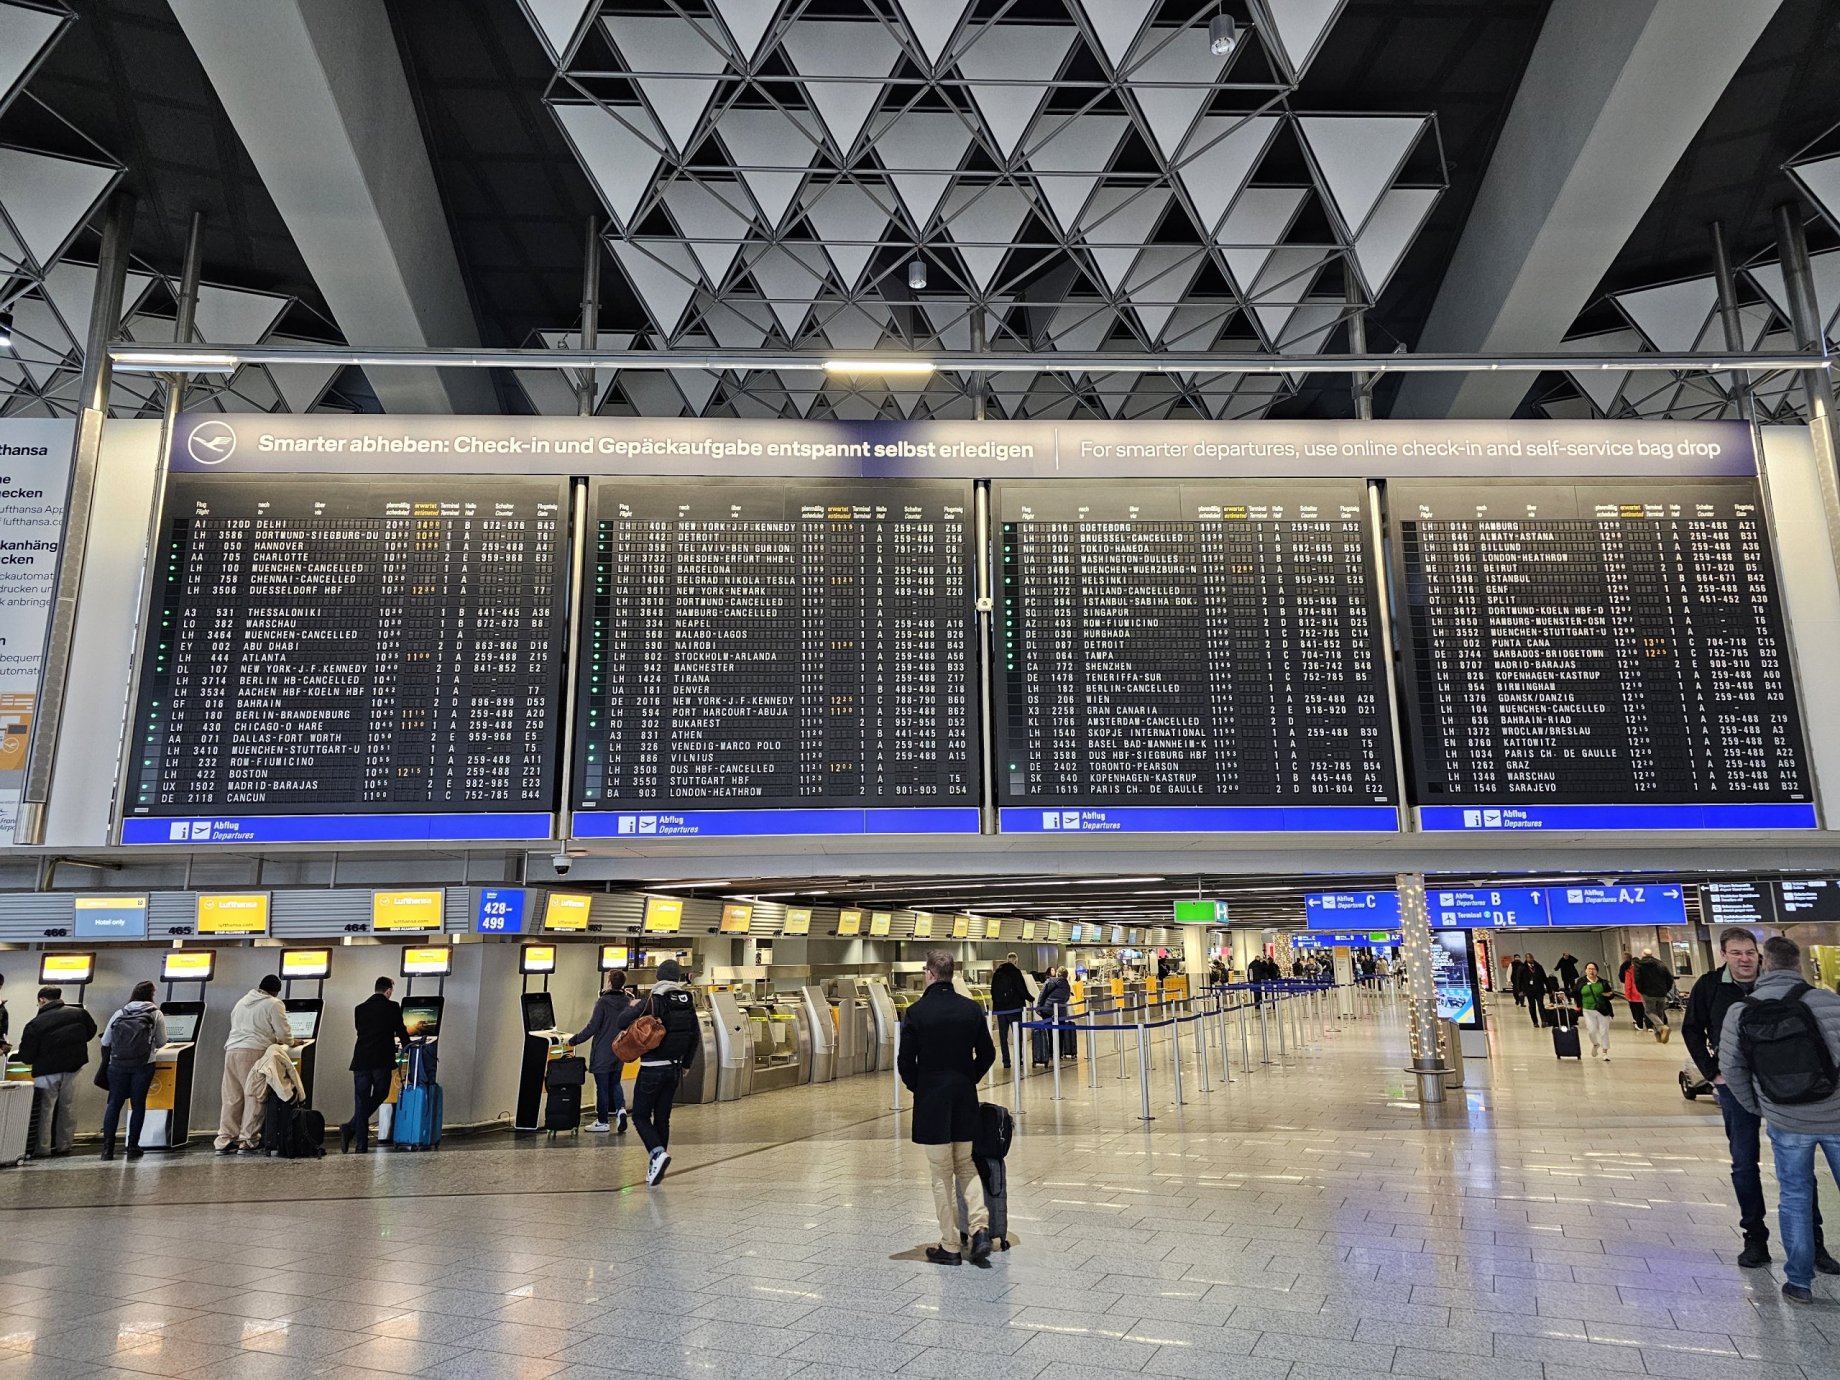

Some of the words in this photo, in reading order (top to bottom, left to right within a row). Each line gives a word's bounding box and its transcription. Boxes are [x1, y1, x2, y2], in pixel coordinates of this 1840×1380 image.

[258, 435, 347, 452] Smarter
[350, 436, 449, 452] abheben:
[454, 436, 549, 453] Check-in
[555, 438, 593, 453] und
[598, 438, 762, 458] Gepäckaufgabe
[767, 441, 870, 460] entspannt
[874, 439, 936, 458] selbst
[940, 441, 1033, 461] erledigen
[1082, 441, 1112, 457] For
[1116, 443, 1189, 457] smarter
[1193, 438, 1299, 460] departures,
[1304, 444, 1337, 456] use
[1342, 440, 1397, 456] online
[1402, 439, 1485, 456] check-in
[1487, 440, 1522, 456] and
[1526, 440, 1633, 456] self-service
[1637, 439, 1674, 459] bag
[1677, 439, 1721, 459] drop
[257, 520, 286, 528] DELHI
[678, 533, 719, 541] DETROIT
[254, 542, 303, 550] HANNOVER
[1481, 543, 1521, 551] BILLUND
[253, 553, 308, 561] CHARLOTTE
[678, 565, 730, 573] BARCELONA
[1082, 576, 1126, 584] HELSINKI
[1486, 575, 1530, 583] ISTANBUL
[1487, 596, 1515, 604] SPLIT
[248, 608, 321, 617] THESSALONIKI
[1083, 608, 1129, 616] SINGAPUR
[246, 619, 296, 628] WARSCHAU
[676, 619, 710, 627] NEAPEL
[675, 641, 715, 649] NAIROBI
[242, 653, 286, 662] ATLANTA
[675, 652, 776, 660] STOCKHOLM-ARLANDA
[1085, 651, 1113, 659] TAMPA
[674, 663, 734, 672] MANCHESTER
[1086, 662, 1131, 671] SHENZHEN
[1086, 673, 1161, 681] TENERIFFA-SUR
[673, 686, 709, 694] DENVER
[1497, 683, 1555, 691] BIRMINGHAM
[1086, 695, 1109, 703] WIEN
[1498, 693, 1574, 702] GDANSK/DANZIG
[237, 699, 281, 708] BAHRAIN
[672, 719, 720, 728] BUKAREST
[1501, 716, 1571, 724] BAHRAIN-RIAD
[234, 722, 292, 731] CHICAGO-O
[298, 722, 322, 730] HARE
[610, 731, 621, 740] A3
[641, 731, 658, 739] 831
[671, 731, 702, 739] ATHEN
[895, 729, 936, 737] 441-445
[948, 729, 965, 737] A34
[1088, 728, 1122, 737] SKOPJE
[1131, 728, 1206, 737] INTERNATIONAL
[233, 734, 303, 743] DALLAS-FORT
[310, 733, 341, 742] WORTH
[1503, 738, 1556, 746] KATTOWITZ
[672, 741, 750, 750] VENEDIG-MARCO
[757, 741, 781, 750] POLO
[166, 759, 178, 767] LH
[198, 758, 217, 767] 232
[230, 757, 314, 766] ROM-FIUMICINO
[468, 755, 510, 764] 259-488
[523, 755, 541, 763] A11
[671, 753, 713, 762] VILNIUS
[1030, 762, 1041, 771] DE
[1054, 762, 1076, 771] 2402
[1089, 762, 1178, 771] TORONTO-PEARSON
[1311, 762, 1351, 770] 752-785
[1363, 762, 1380, 770] B54
[1506, 761, 1529, 769] GRAZ
[229, 769, 268, 778] BOSTON
[1090, 773, 1196, 782] KOPENHAGEN-KASTRUP
[1448, 773, 1459, 781] LH
[1473, 772, 1495, 781] 1348
[1507, 772, 1555, 780] WARSCHAU
[1727, 771, 1768, 779] 259-488
[1780, 771, 1797, 779] A14
[163, 782, 176, 791] UX
[191, 782, 214, 791] 1502
[228, 780, 318, 790] MADRID-BARAJAS
[466, 779, 509, 787] 982-985
[523, 778, 540, 787] E23
[1031, 785, 1041, 793] AF
[1056, 785, 1078, 793] 1619
[1091, 785, 1120, 793] PARIS
[1126, 785, 1143, 793] CH.
[1150, 785, 1161, 793] DE
[1168, 785, 1203, 793] GAULLE
[1312, 784, 1353, 793] 801-804
[1366, 784, 1383, 792] E22
[1449, 784, 1461, 792] LH
[1474, 784, 1496, 792] 1546
[1509, 783, 1556, 792] SARAJEVO
[1729, 782, 1769, 790] 259-488
[1781, 782, 1798, 790] B32
[607, 789, 619, 797] BA
[639, 789, 656, 797] 903
[670, 787, 762, 797] LONDON-HEATHROW
[896, 786, 936, 794] 901-903
[949, 786, 966, 794] D54
[161, 794, 173, 803] DE
[188, 794, 213, 802] 2118
[227, 793, 265, 802] CANCUN
[466, 790, 508, 799] 752-785
[522, 790, 539, 798] B44
[1082, 812, 1105, 821] Abflug
[1503, 810, 1527, 819] Abflug
[659, 816, 684, 825] Abflug
[1504, 819, 1542, 828] Departures
[214, 821, 239, 831] Abflug
[659, 825, 698, 835] Departures
[1082, 821, 1120, 830] Departures
[212, 831, 254, 840] Departures
[1491, 892, 1501, 905] B
[1619, 888, 1645, 904] A,Z
[1366, 895, 1376, 908] C
[484, 902, 512, 914] 428-
[482, 917, 504, 929] 499
[1493, 911, 1516, 927] D,E
[44, 928, 68, 937] 466
[168, 926, 193, 935] 465
[344, 924, 370, 932] 464
